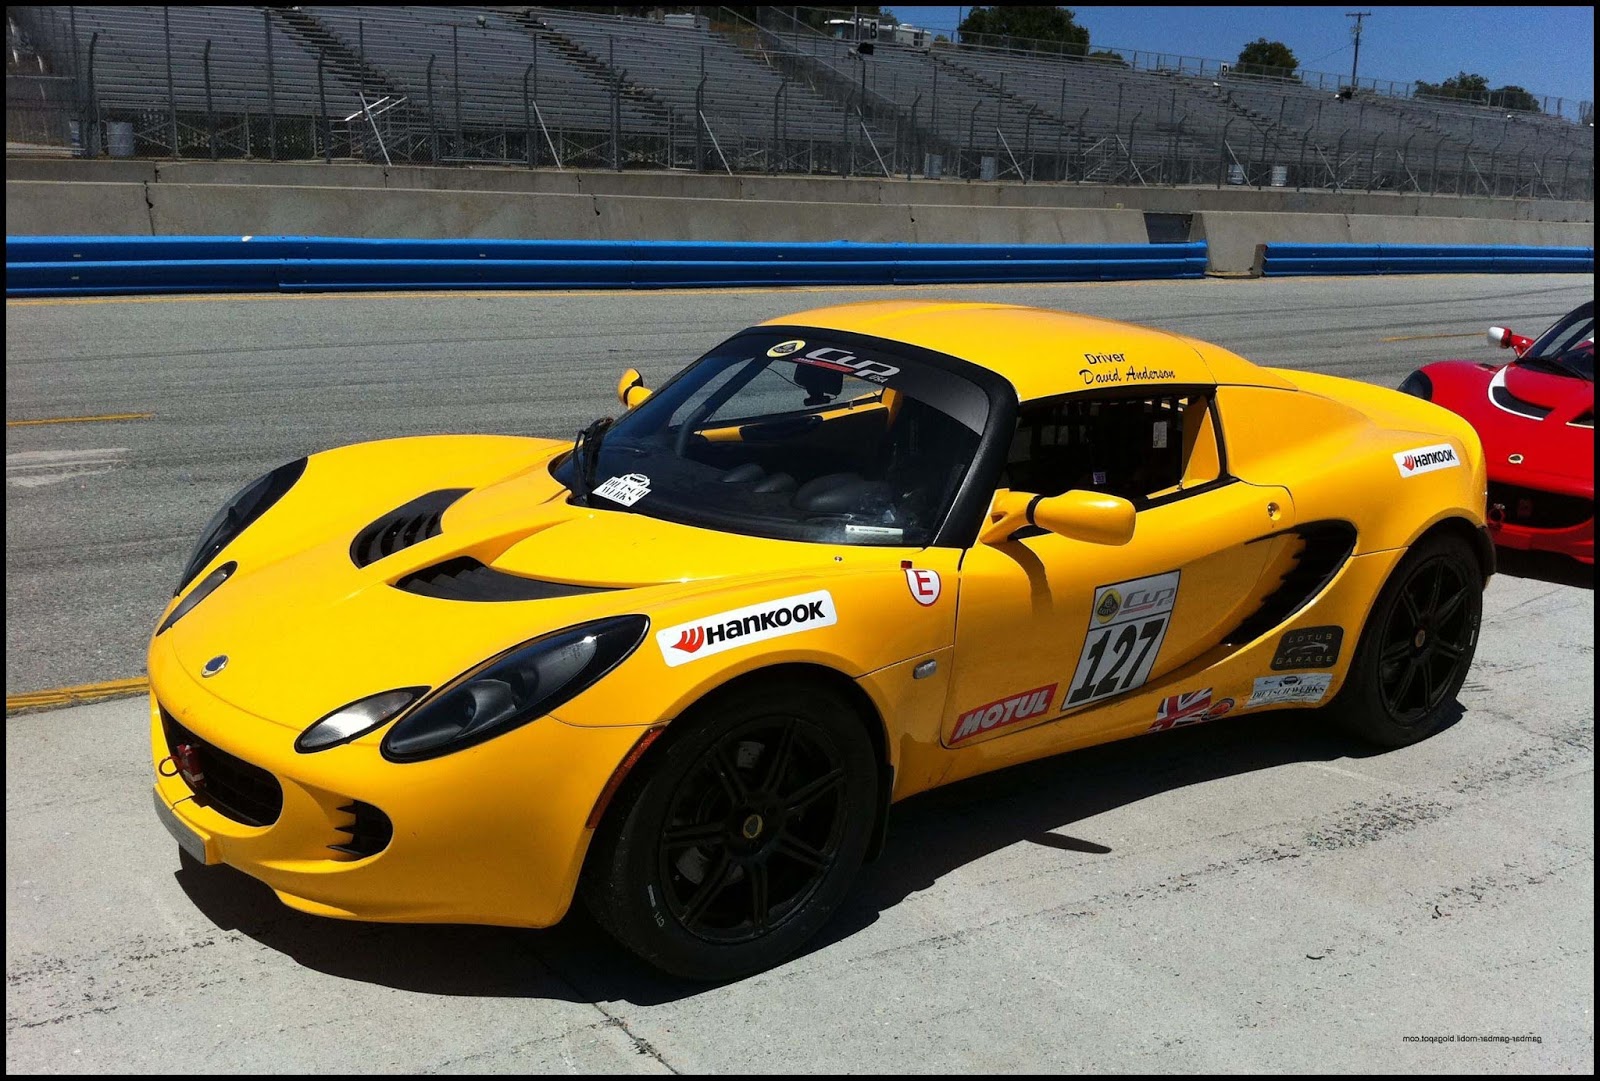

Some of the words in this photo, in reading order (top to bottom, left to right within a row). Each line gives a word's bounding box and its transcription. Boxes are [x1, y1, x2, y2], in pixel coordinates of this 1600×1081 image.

[870, 22, 877, 39] B
[1084, 353, 1125, 365] Driver
[1079, 368, 1121, 385] David
[1126, 365, 1176, 382] Anderson
[912, 570, 934, 596] E
[1288, 633, 1333, 644] LOTUS
[1068, 617, 1166, 704] 127
[1275, 655, 1334, 665] GARAGE
[952, 689, 1049, 741] MOTUL
